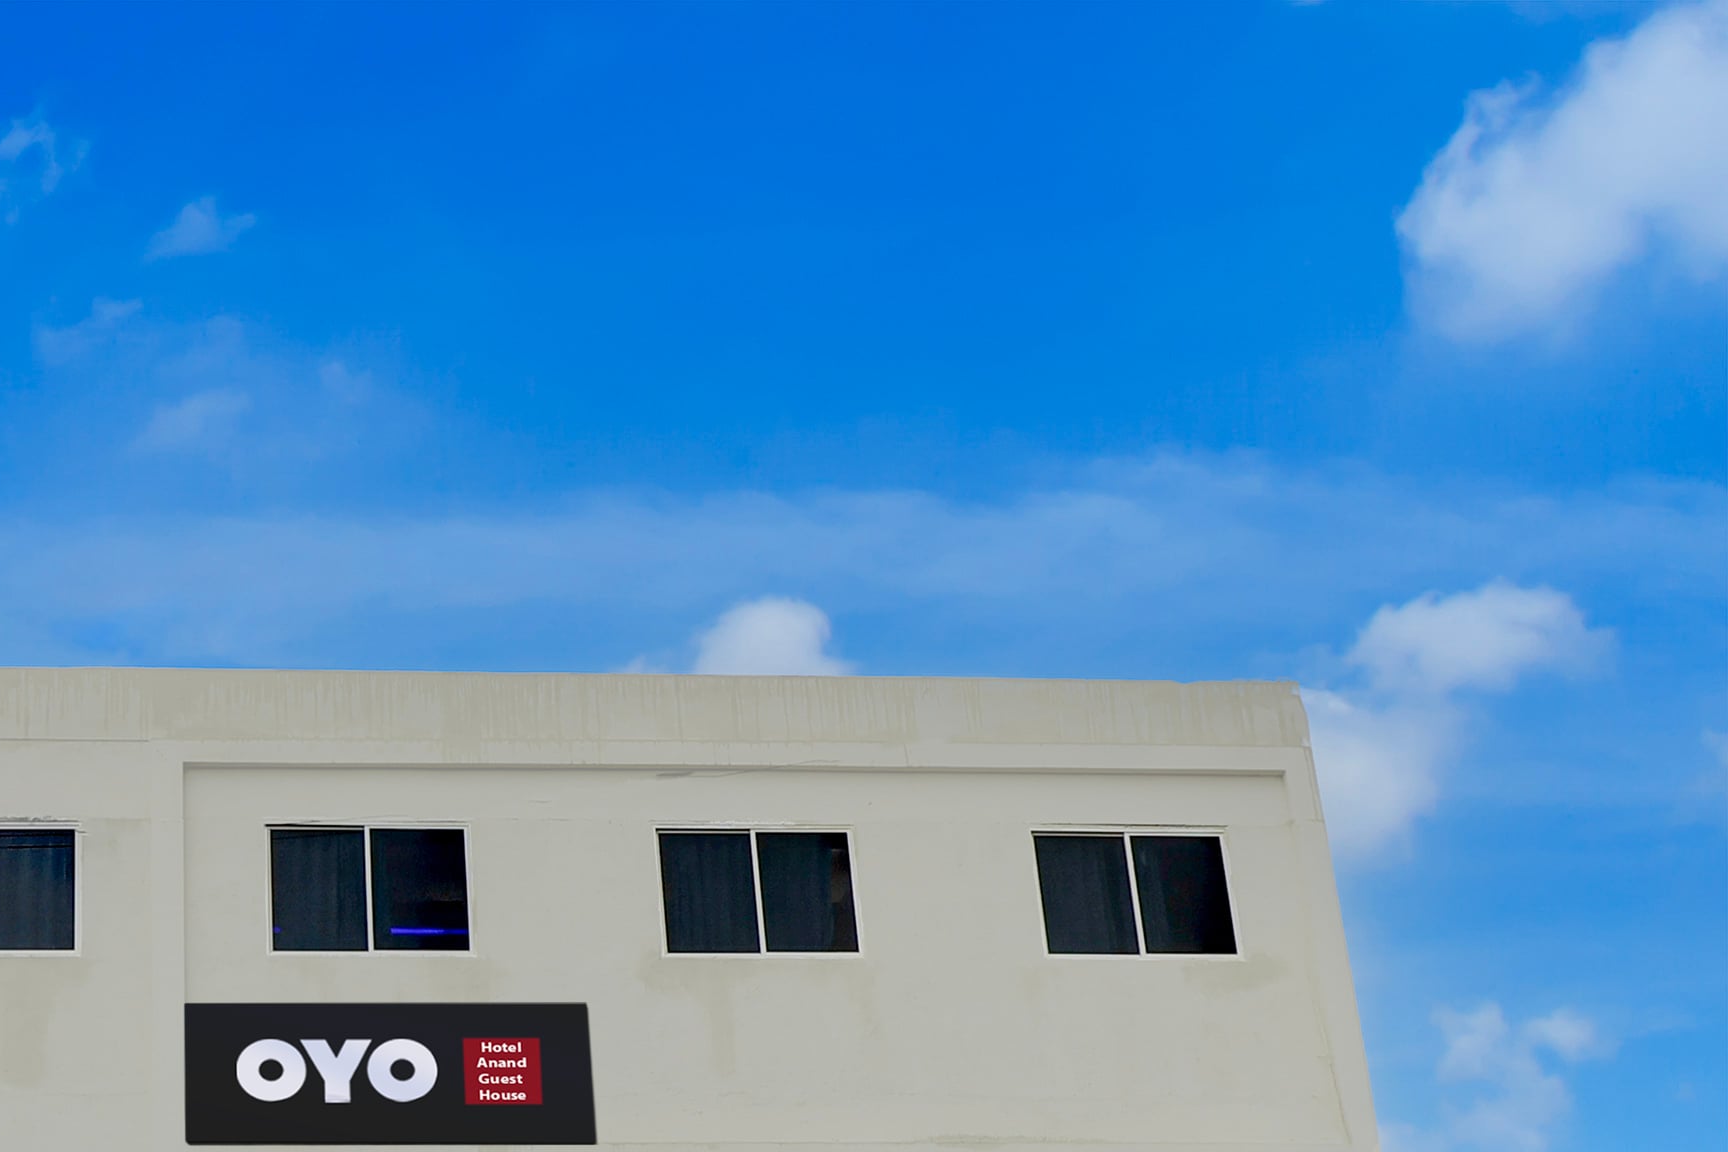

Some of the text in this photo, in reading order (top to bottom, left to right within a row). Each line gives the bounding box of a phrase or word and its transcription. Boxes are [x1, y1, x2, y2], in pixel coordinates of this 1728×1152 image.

[480, 1041, 522, 1054] Hotel
[476, 1056, 528, 1069] Anand
[236, 1038, 439, 1104] OYO
[478, 1072, 523, 1086] Guest
[479, 1088, 527, 1102] House
